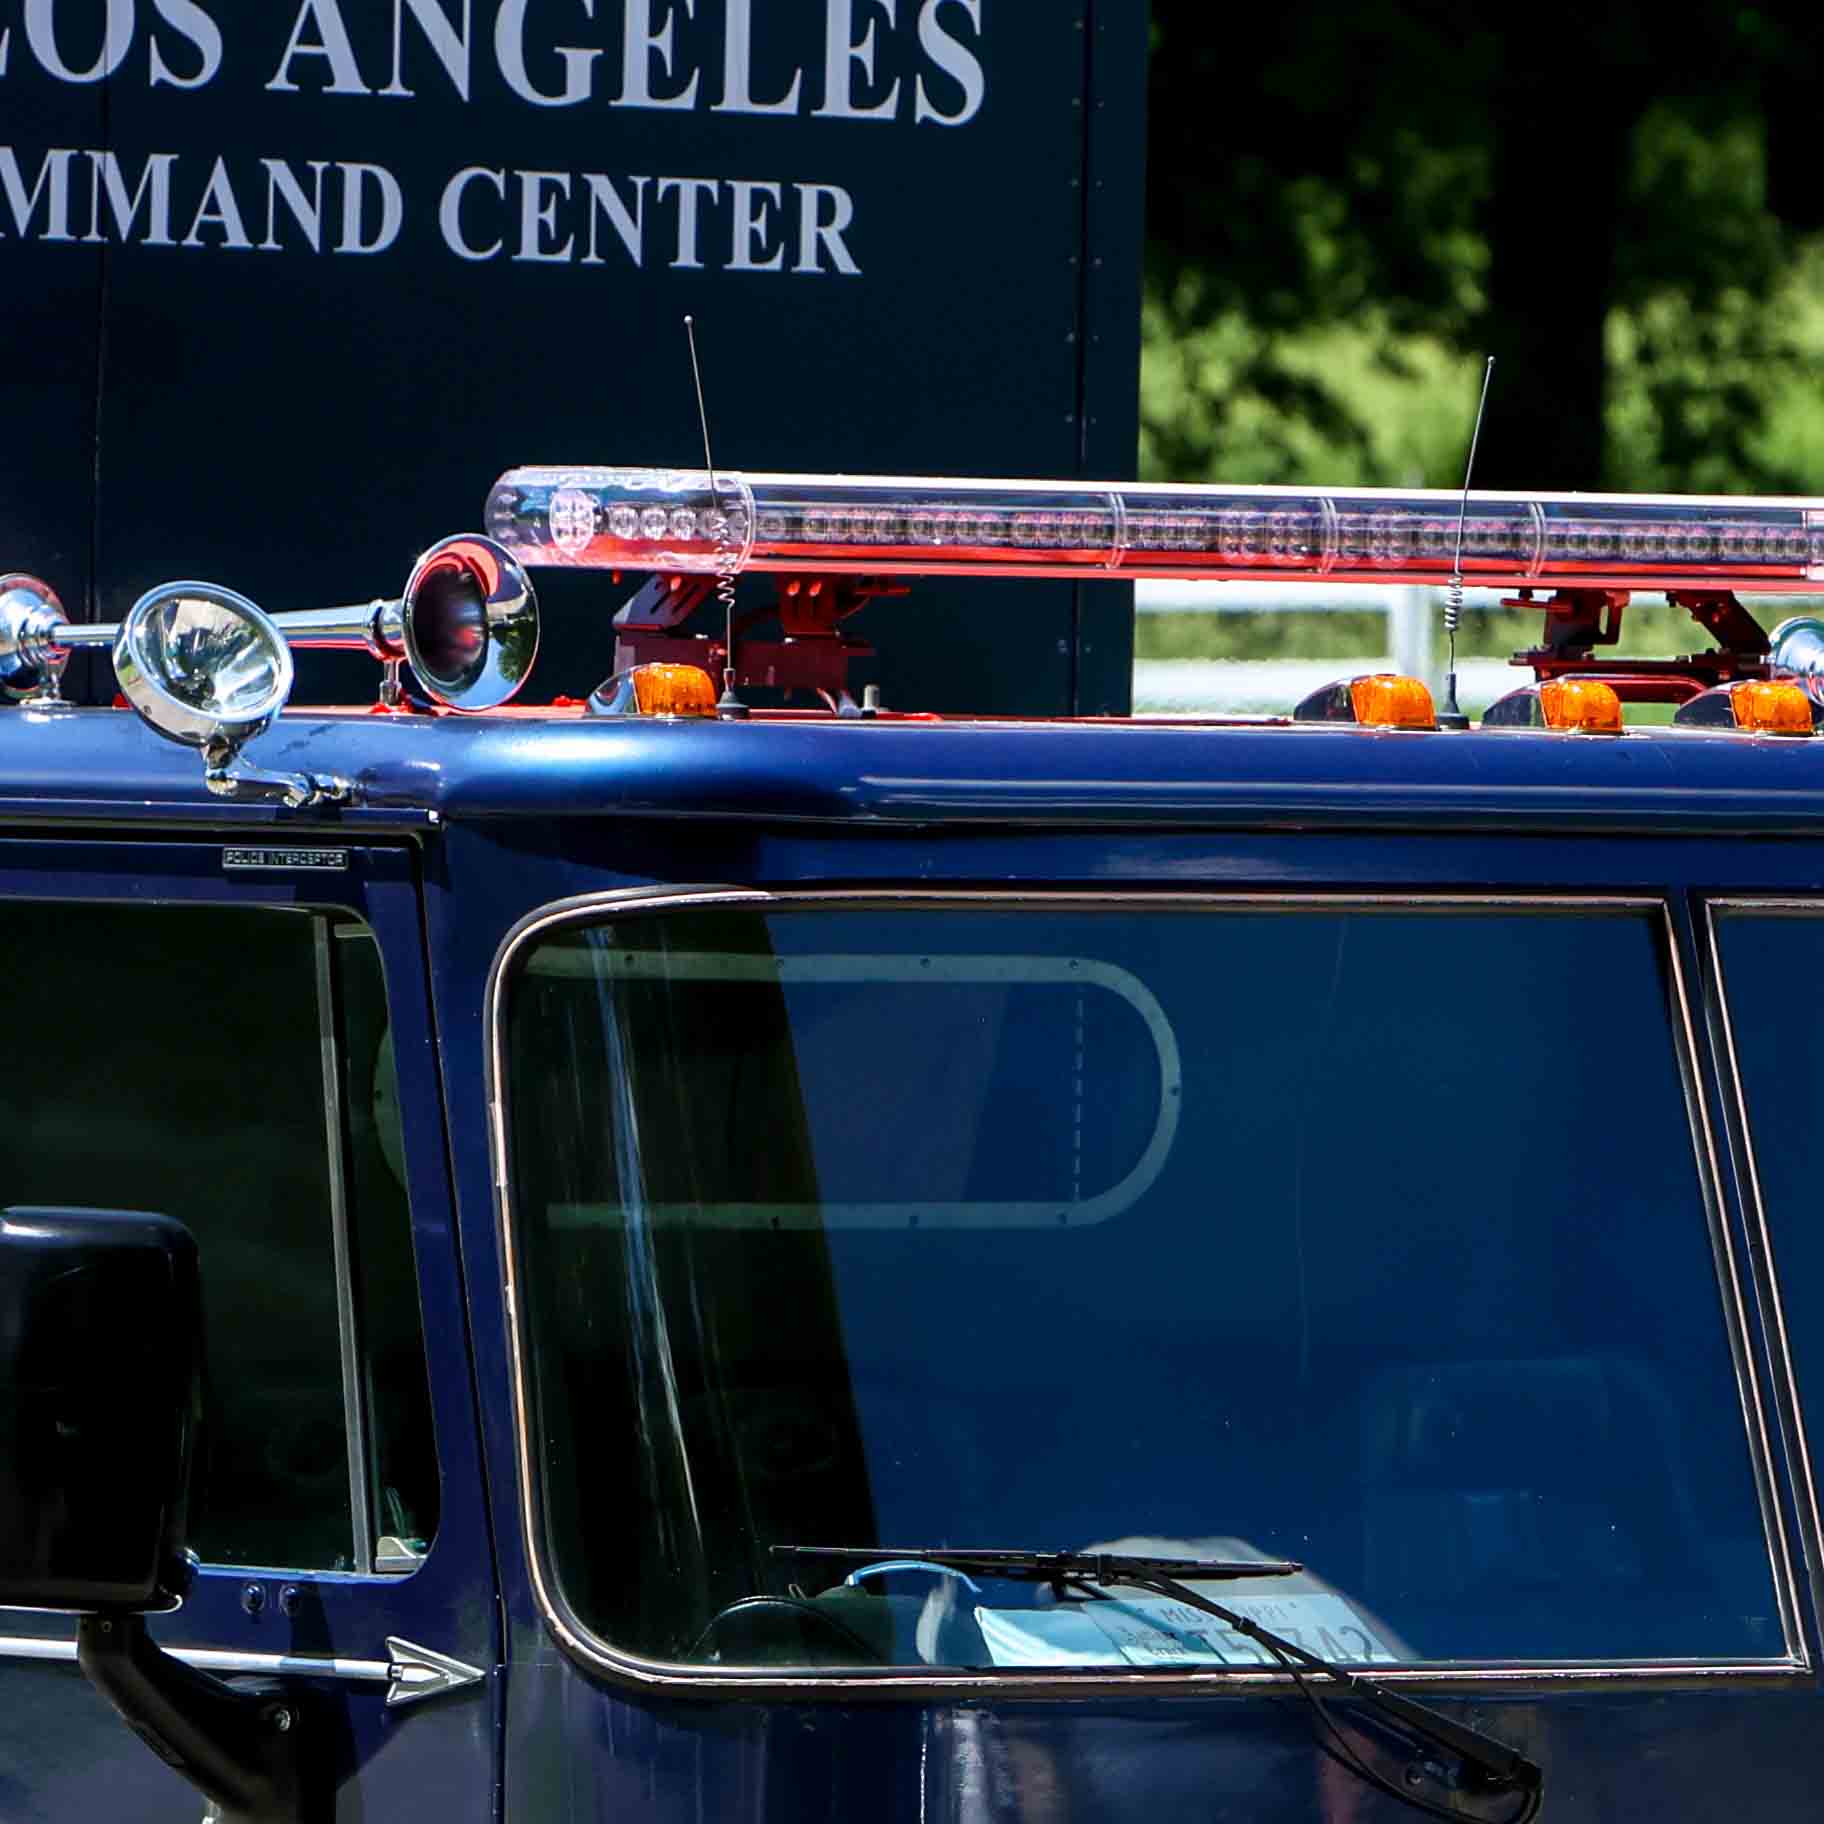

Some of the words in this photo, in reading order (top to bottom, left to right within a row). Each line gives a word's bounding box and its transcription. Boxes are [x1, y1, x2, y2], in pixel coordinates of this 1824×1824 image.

[264, 0, 985, 126] ANGELES
[439, 166, 862, 275] CENTER
[226, 851, 265, 864] POLICE
[269, 853, 344, 866] INTERCEPTOR
